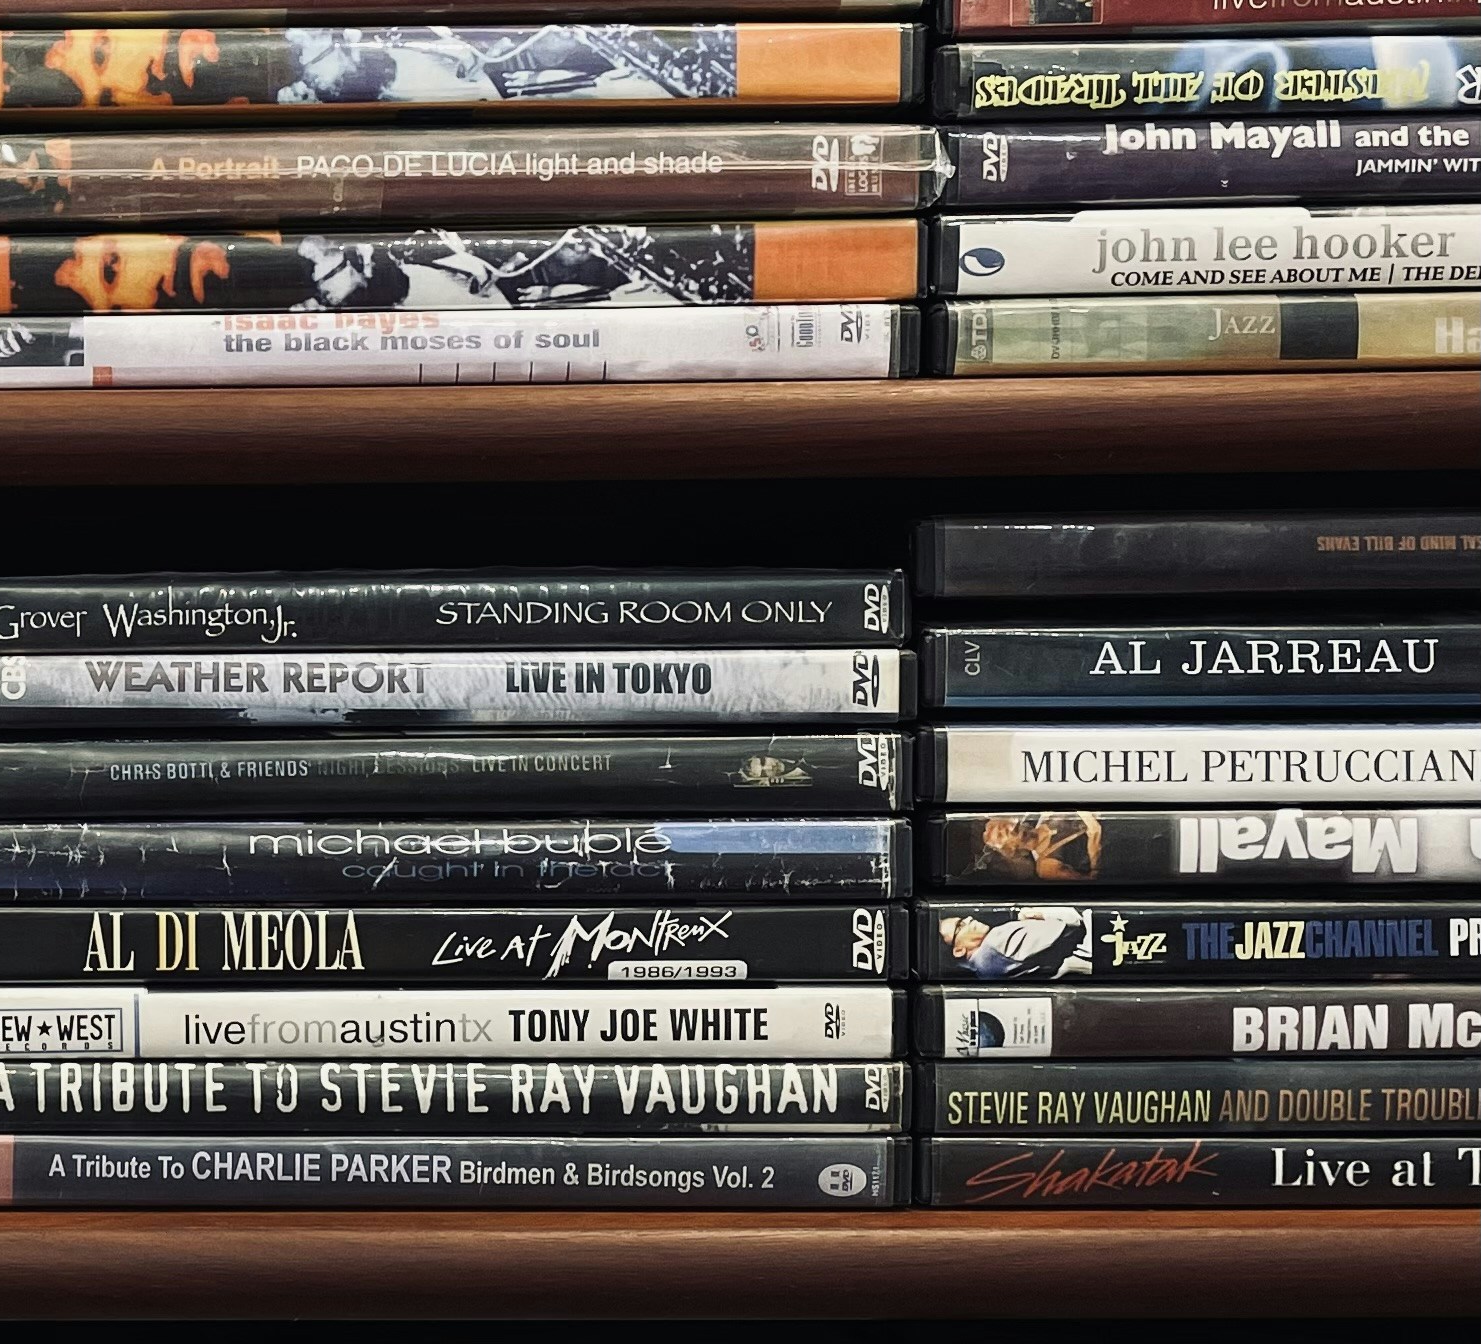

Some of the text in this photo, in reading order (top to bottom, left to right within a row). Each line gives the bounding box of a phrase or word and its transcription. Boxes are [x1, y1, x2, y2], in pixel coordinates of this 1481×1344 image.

[1093, 224, 1456, 273] john lee hooker
[1111, 266, 1381, 286] COME AND SEE ABOUT ME
[436, 601, 832, 625] STANDING ROOM ONLY
[1090, 639, 1438, 676] AL JARREAU
[83, 910, 364, 972] AL DI MEOLA
[620, 964, 738, 978] 1986/1993
[49, 1152, 774, 1191] A Tribute To CHARLIE PARKER Birdmen & Birdsongs Vol. 2
